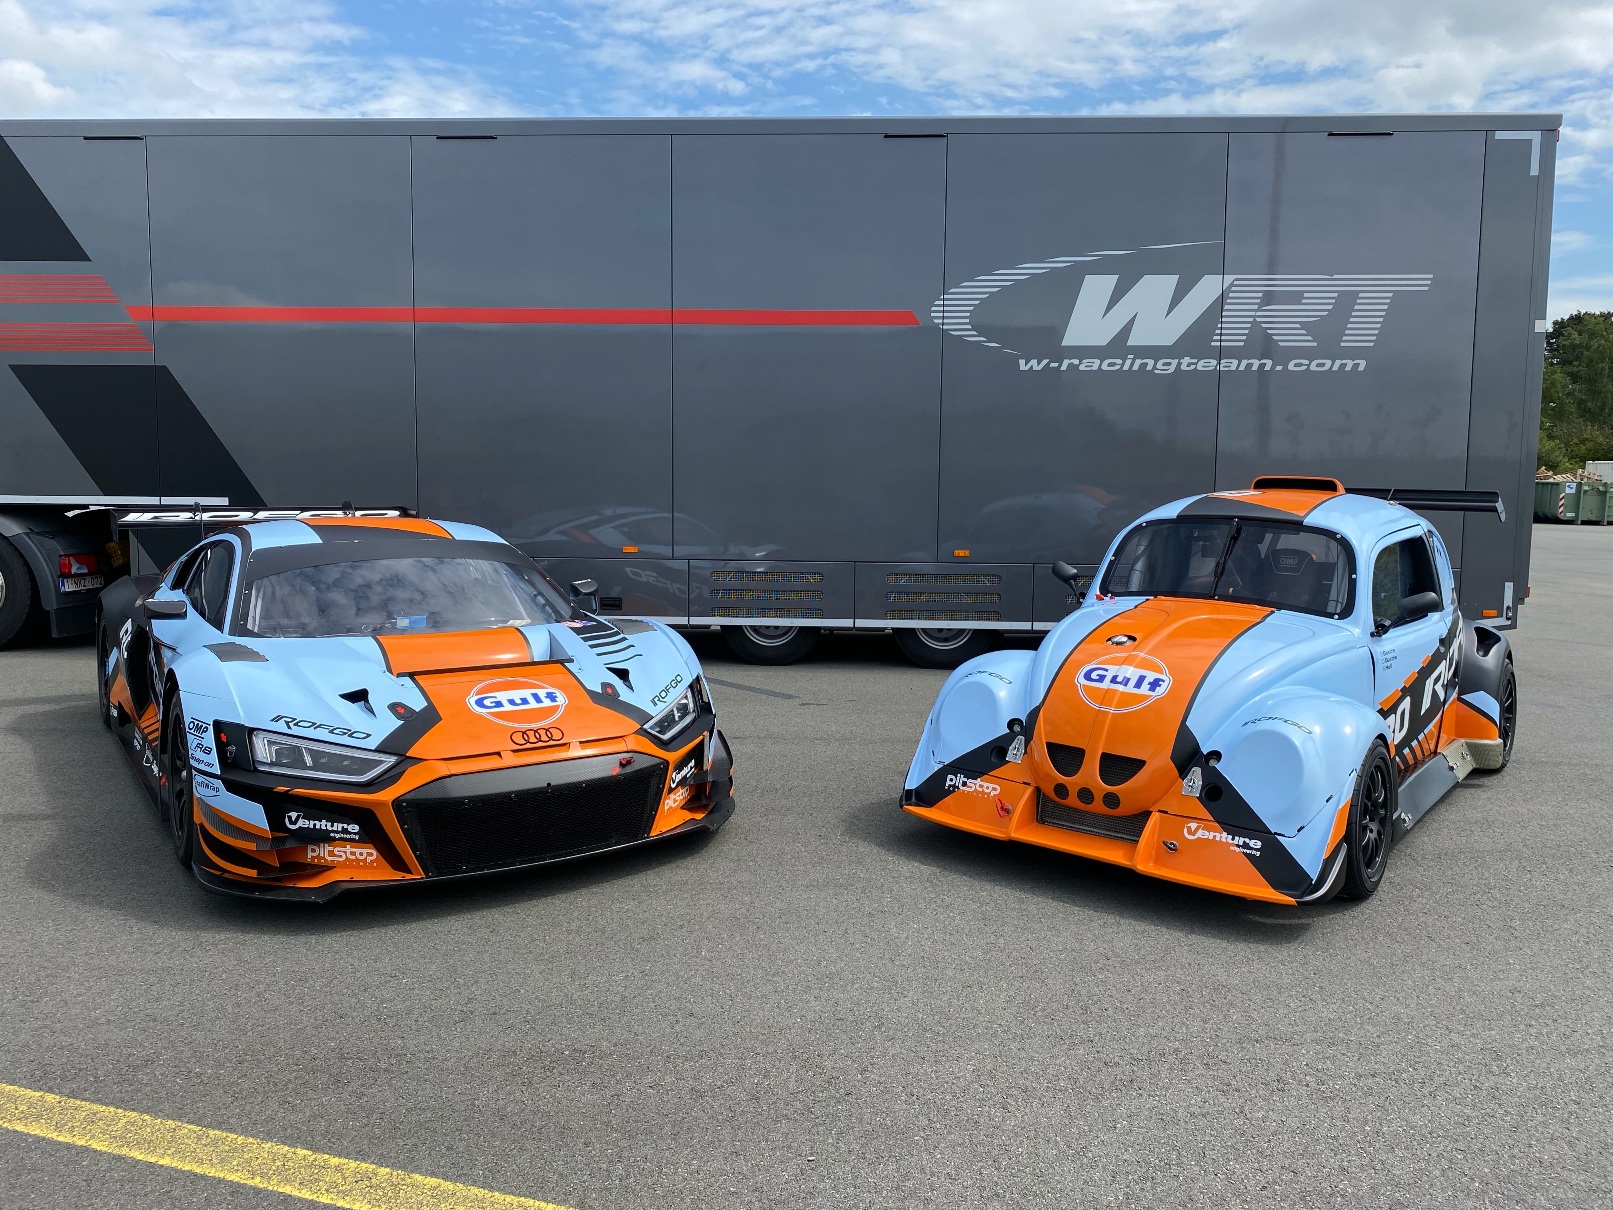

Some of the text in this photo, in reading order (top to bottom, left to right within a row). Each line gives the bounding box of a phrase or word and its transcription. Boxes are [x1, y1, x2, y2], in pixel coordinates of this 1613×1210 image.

[1061, 274, 1433, 347] WRT
[1017, 354, 1367, 375] w-racingteam.com
[1279, 557, 1299, 566] OMP
[650, 673, 684, 707] ROFGO
[1083, 667, 1166, 693] Gulf
[474, 691, 560, 709] Gulf
[188, 720, 209, 735] OMP
[269, 714, 373, 740] ROFGO
[945, 774, 1001, 797] pitstop
[284, 812, 360, 832] Venture
[1183, 822, 1263, 849] Venture
[307, 843, 377, 862] pitstop
